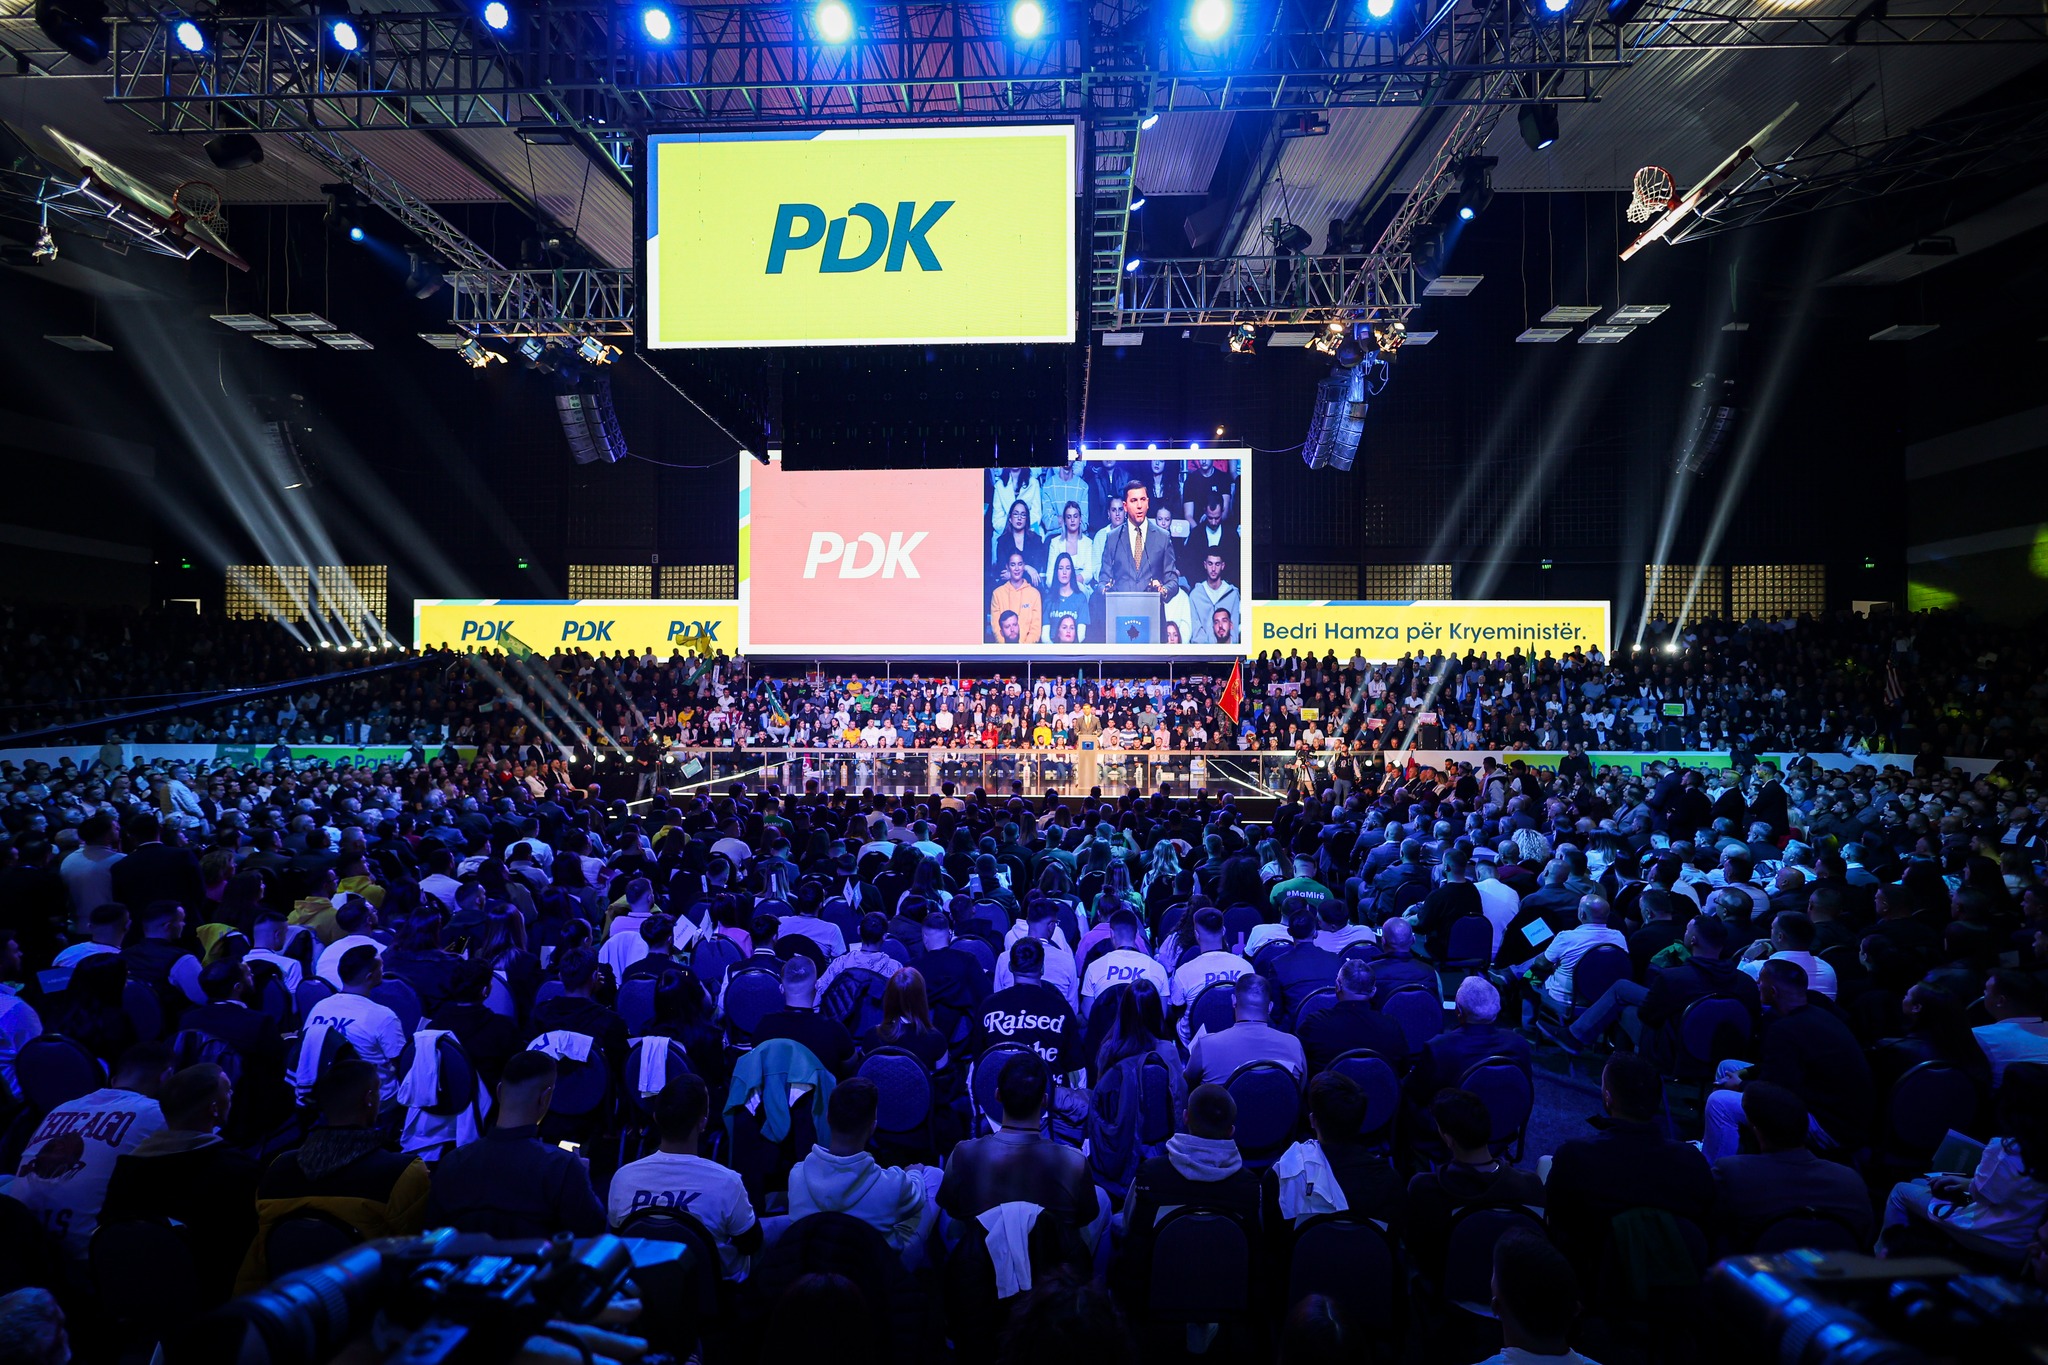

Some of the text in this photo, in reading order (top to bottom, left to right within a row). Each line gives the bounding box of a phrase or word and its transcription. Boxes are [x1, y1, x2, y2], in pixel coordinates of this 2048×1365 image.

[766, 201, 955, 274] PDK
[804, 531, 928, 579] PDK
[461, 620, 514, 641] PDK
[561, 620, 615, 641] PDK
[667, 620, 721, 641] PDK
[1263, 622, 1587, 643] Bedri Hamza për Kryeministër.
[1286, 890, 1325, 900] #MaMirë
[1106, 966, 1146, 980] PDK
[983, 1009, 1066, 1036] Raised
[1027, 1041, 1059, 1062] he
[630, 1190, 702, 1213] PDK
